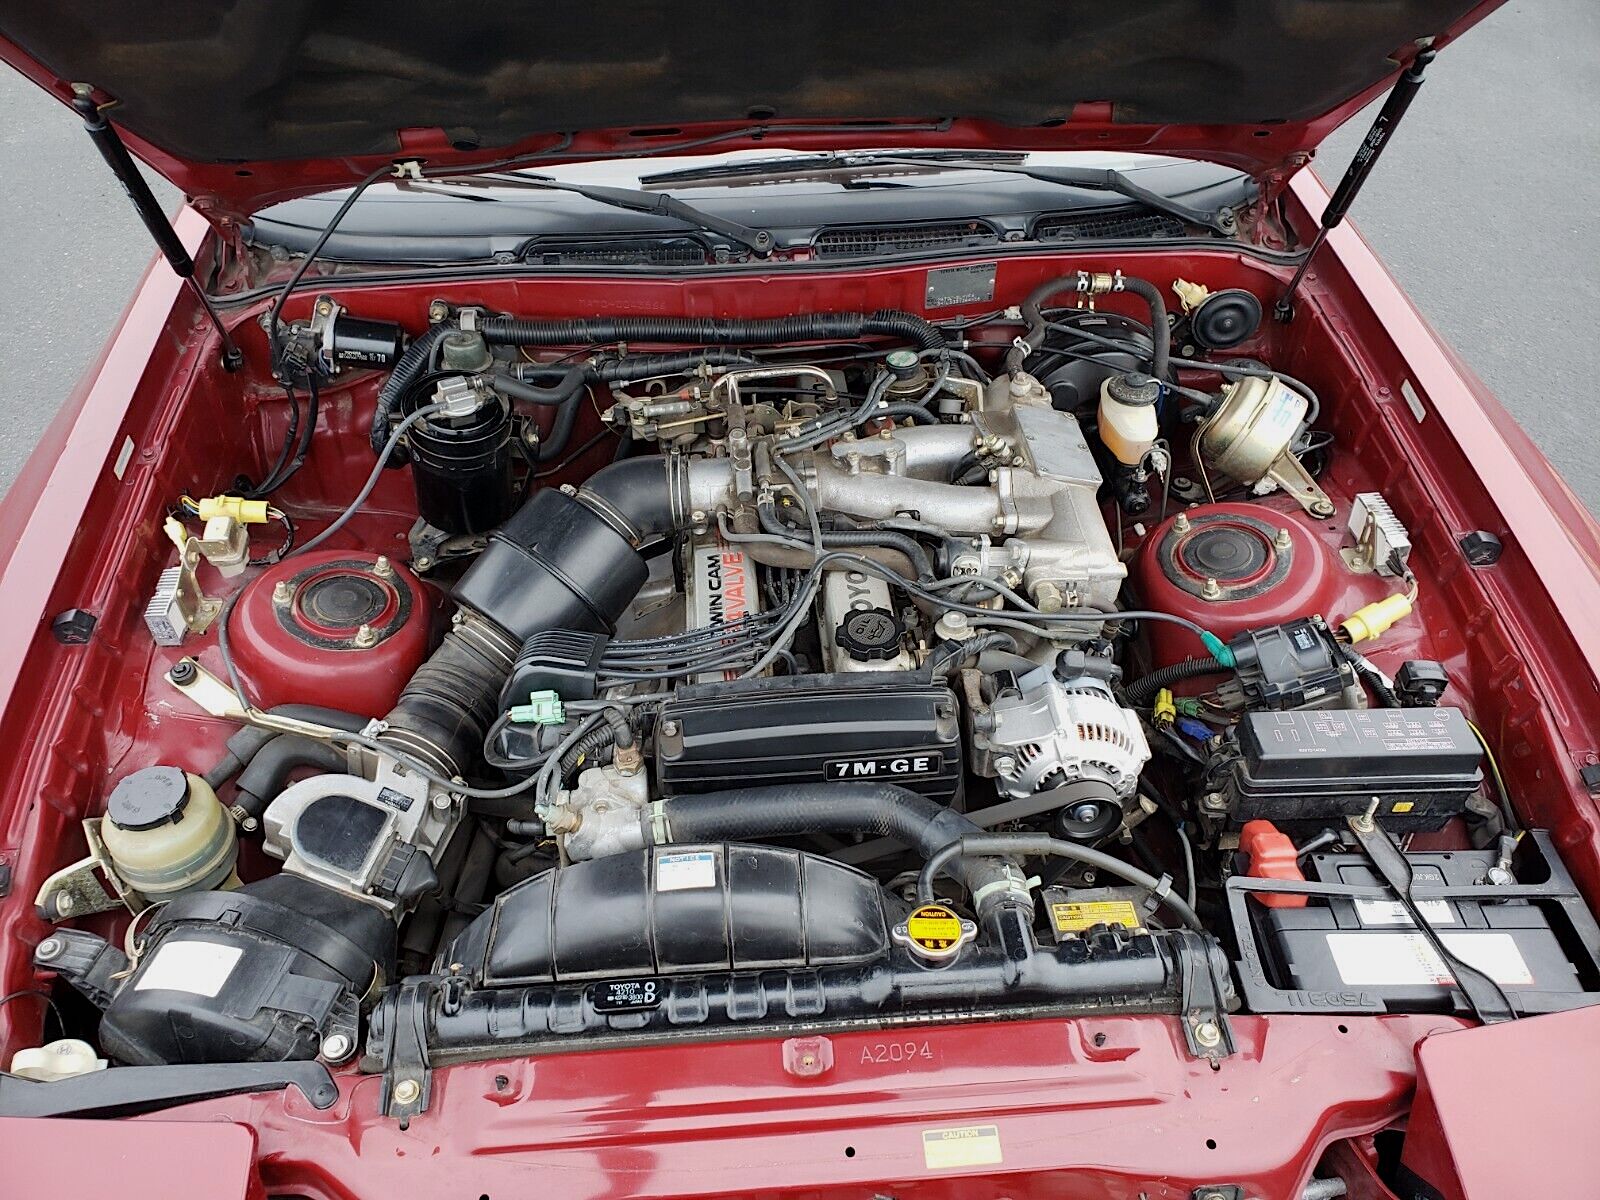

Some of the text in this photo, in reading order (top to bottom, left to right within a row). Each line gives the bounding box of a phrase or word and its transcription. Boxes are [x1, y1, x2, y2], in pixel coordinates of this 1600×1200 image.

[722, 551, 746, 609] VALVE
[845, 571, 874, 611] OYO
[706, 553, 725, 630] WIN CAM
[856, 618, 871, 635] OIL
[835, 757, 930, 777] 7M-GE
[609, 982, 641, 991] TOYOTA
[860, 1041, 934, 1065] A2094
[943, 1128, 979, 1140] CAUTION
